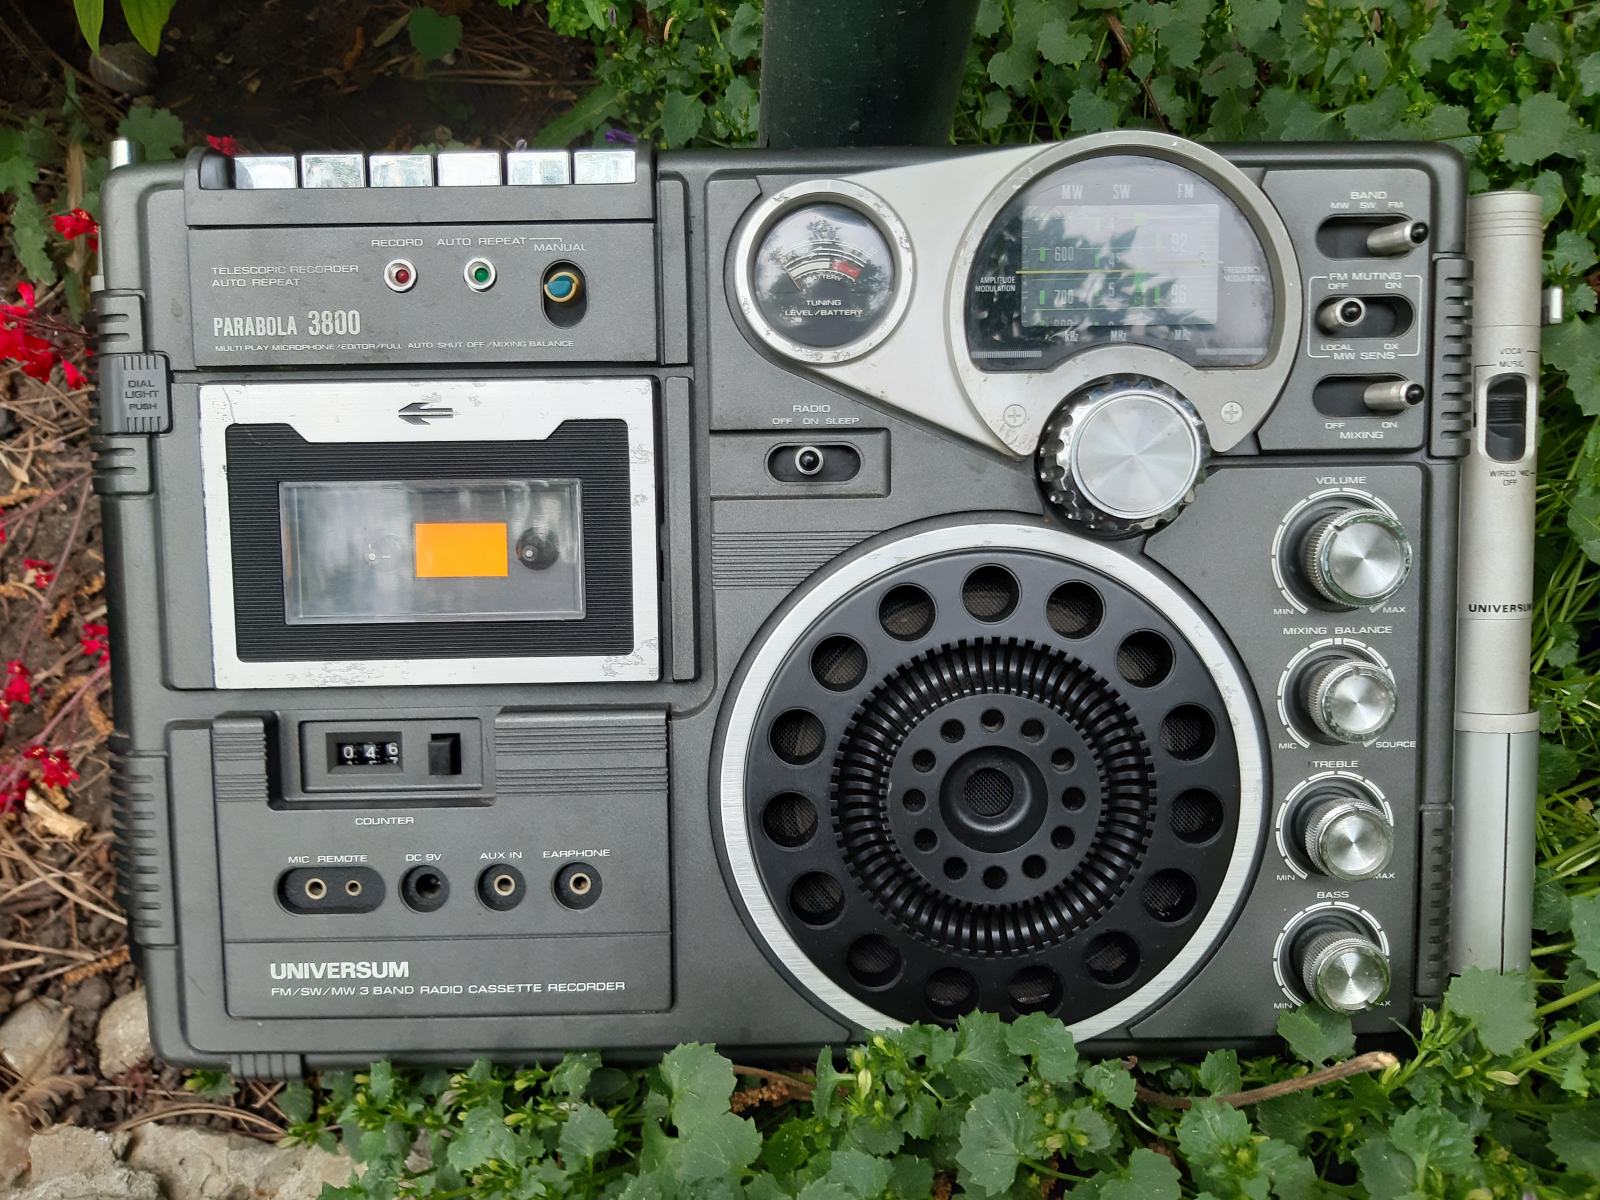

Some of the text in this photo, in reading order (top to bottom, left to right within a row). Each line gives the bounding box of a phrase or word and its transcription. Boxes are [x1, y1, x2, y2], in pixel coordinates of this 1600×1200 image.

[1113, 184, 1131, 199] SW
[1350, 191, 1387, 200] BAND
[371, 239, 423, 247] RECORD
[437, 237, 527, 246] AUTO REPEAT
[534, 243, 586, 251] MANUAL
[1055, 247, 1074, 261] 600
[211, 265, 359, 275] TELESCOPIC RECORDER
[1329, 272, 1402, 281] FM MUTING
[211, 278, 300, 287] AUTO REPEAT
[975, 285, 1016, 293] MODULATION
[1108, 282, 1115, 297] 5
[213, 310, 361, 337] PARABOLA 3800
[407, 341, 434, 349] AUTO
[437, 341, 463, 349] SHUT
[1333, 351, 1396, 360] MW SENS
[128, 380, 155, 388] DIAL
[792, 404, 831, 413] RADIO
[802, 417, 819, 425] ON
[825, 417, 860, 425] SLEEP
[1325, 422, 1345, 430] OFF
[1339, 431, 1384, 440] MIXING
[1315, 476, 1367, 485] VOLUME
[1382, 606, 1406, 614] MAX
[1283, 625, 1393, 635] MIXING BALANCE
[1375, 740, 1416, 748] SOURCE
[1312, 760, 1359, 768] TREBLE
[355, 816, 414, 825] COUNTER
[405, 852, 442, 861] DC 9V
[479, 851, 523, 859] AUX IN
[543, 849, 611, 858] EARPHONE
[288, 854, 368, 863] MIC REMOTE
[1316, 891, 1350, 899] BASS
[270, 962, 409, 979] UNIVERSUM
[271, 982, 625, 996] FM/SW/MW 3 BAND RADIO CASSETTE RECORDER
